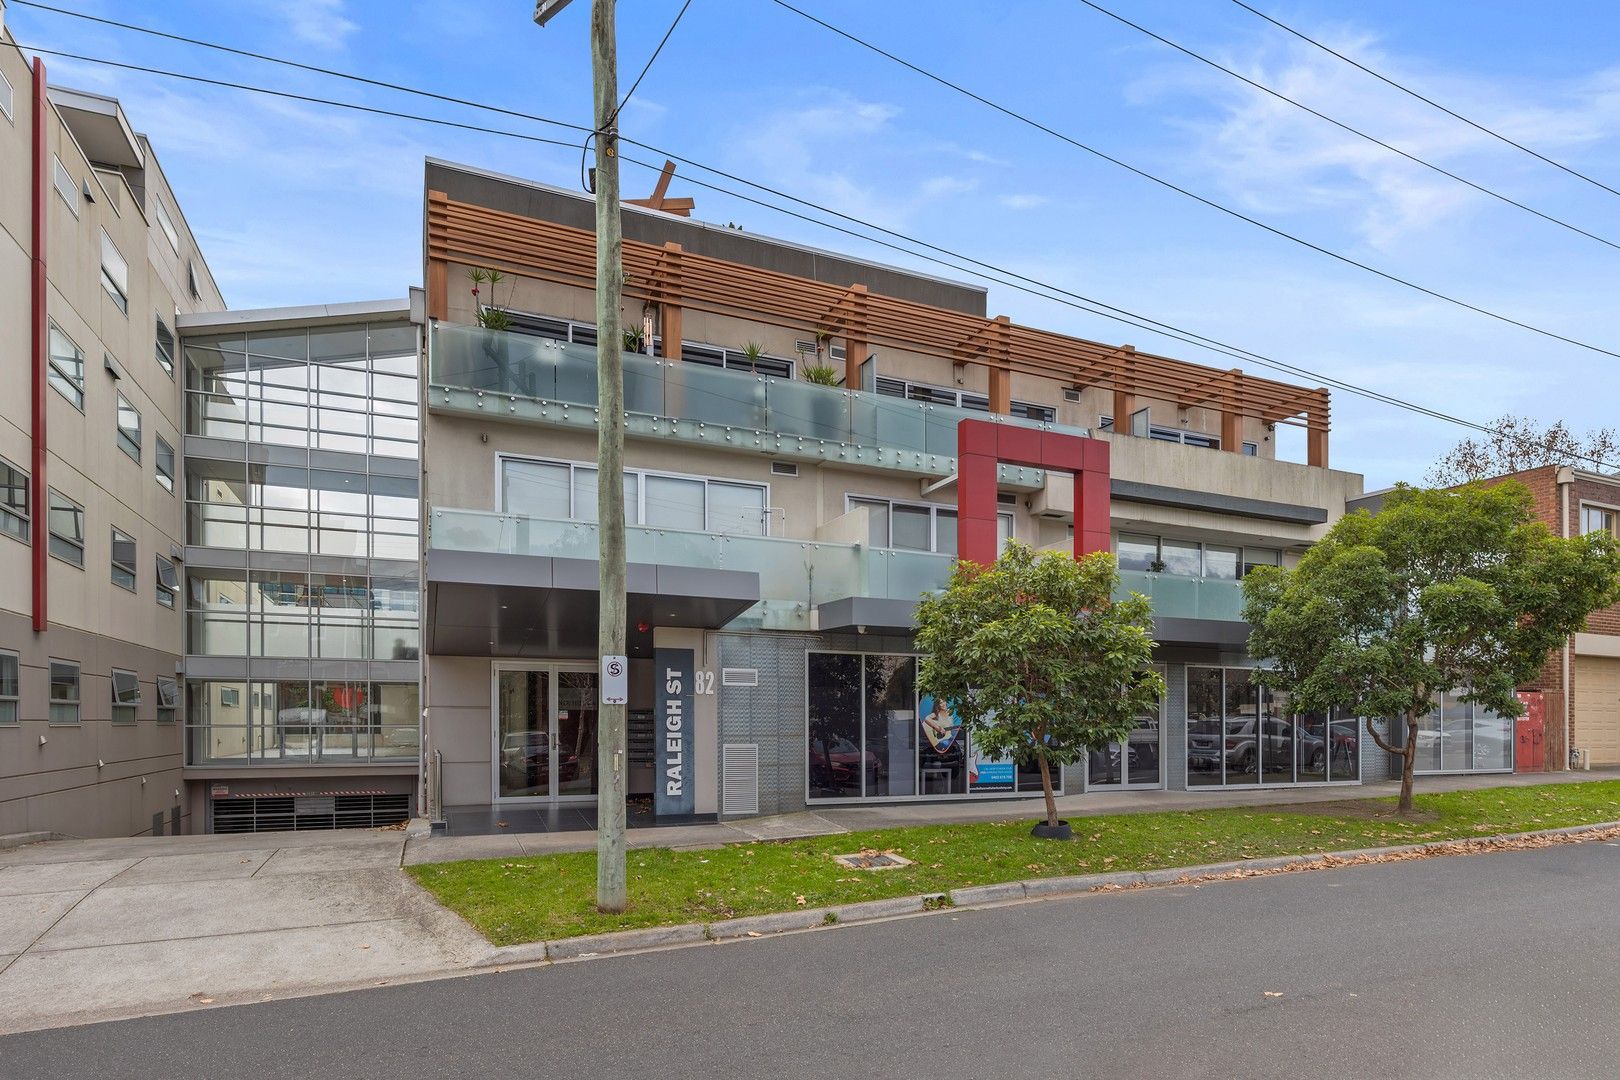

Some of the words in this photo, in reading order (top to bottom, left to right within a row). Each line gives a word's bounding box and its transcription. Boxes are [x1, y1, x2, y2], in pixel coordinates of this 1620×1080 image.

[666, 667, 682, 695] ST
[695, 670, 714, 695] 82
[666, 699, 682, 796] RALEIGH
